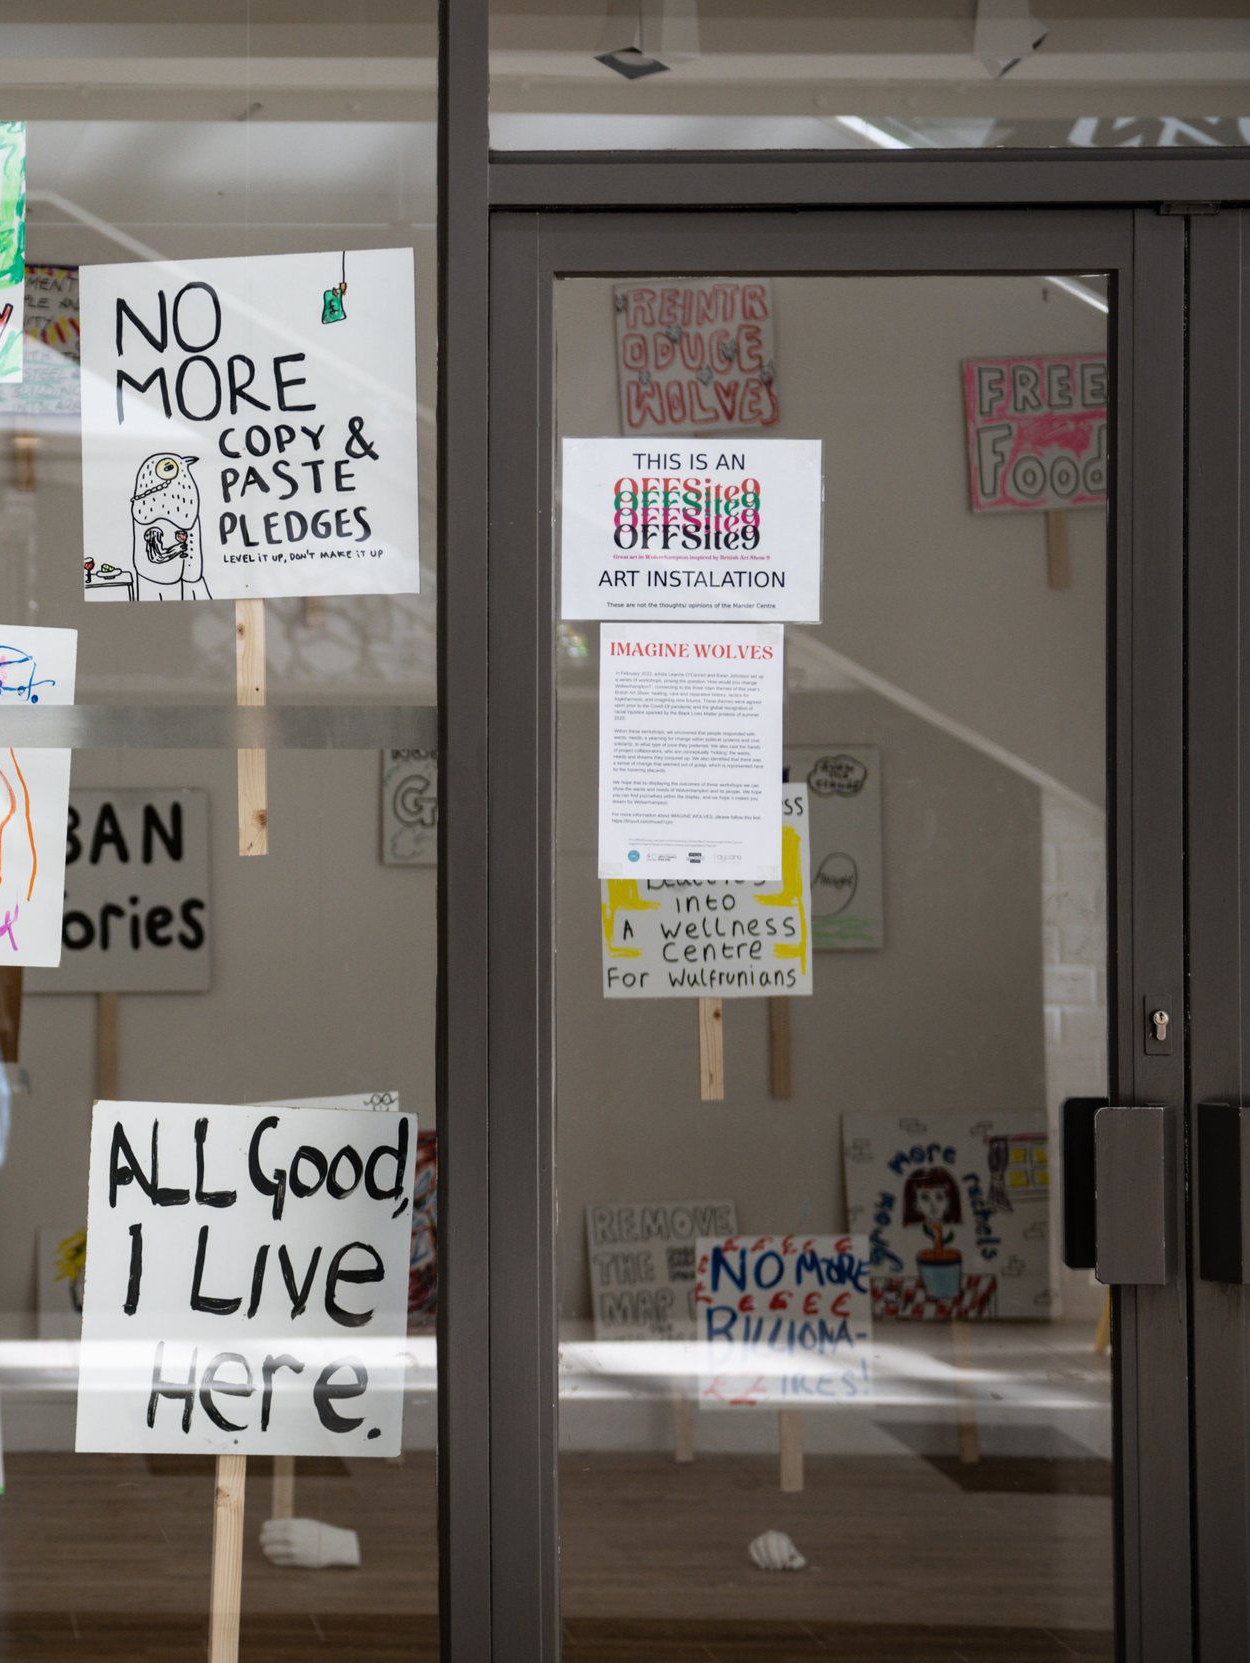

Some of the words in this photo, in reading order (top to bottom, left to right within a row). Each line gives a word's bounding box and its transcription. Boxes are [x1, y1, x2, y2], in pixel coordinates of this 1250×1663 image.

[116, 281, 221, 356] NO
[116, 353, 316, 425] MORE
[626, 377, 779, 428] WOLVES
[978, 363, 1107, 416] FREE
[219, 424, 325, 459] COPY
[345, 416, 380, 461] &
[221, 459, 357, 503] PASTE
[632, 453, 681, 471] THIS
[690, 453, 708, 471] IS
[715, 453, 746, 471] AN
[219, 506, 372, 548] PLEDGES
[223, 553, 256, 564] LEVEL
[598, 570, 640, 587] ART
[647, 570, 786, 588] INSTALATION
[610, 641, 690, 658] IMAGINE
[694, 643, 774, 660] WOLVES
[66, 801, 184, 867] BAN
[62, 893, 206, 951] ories
[623, 920, 634, 941] A
[660, 916, 797, 941] Wellness
[662, 940, 762, 963] Centre
[607, 967, 649, 989] For
[668, 964, 797, 989] Wulfrunians
[109, 1116, 238, 1209] ALL
[591, 1204, 736, 1245] REMOVE
[123, 1223, 142, 1316] I
[711, 1245, 784, 1293] NO
